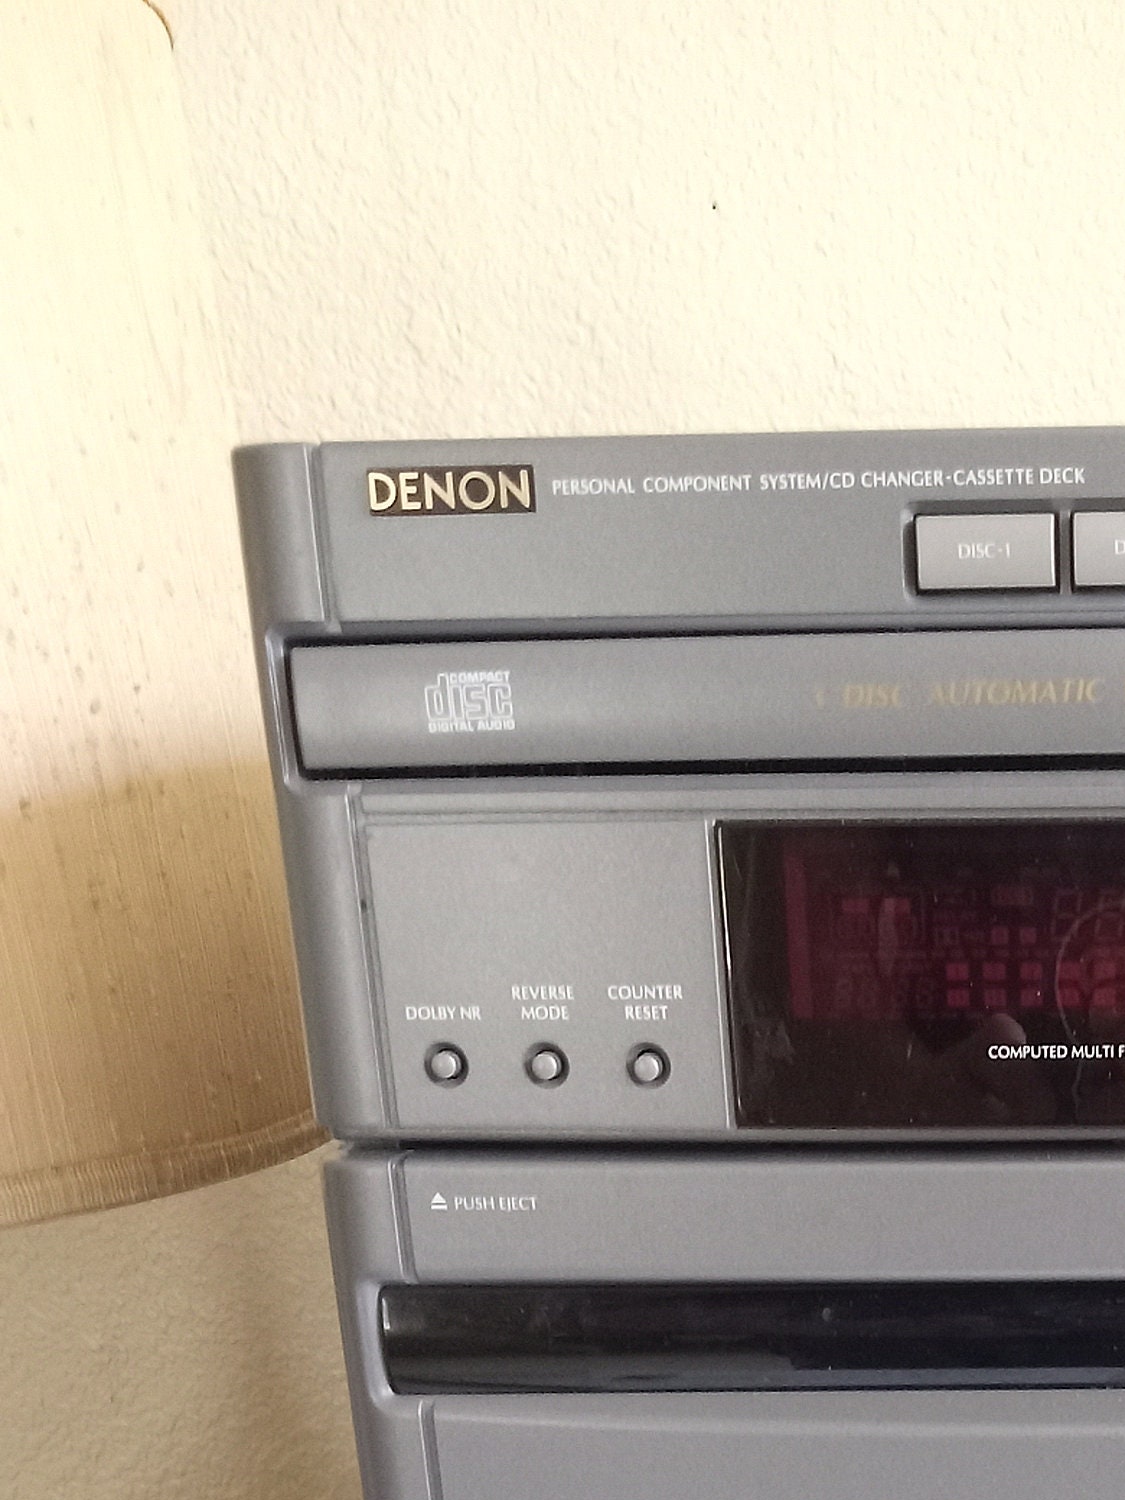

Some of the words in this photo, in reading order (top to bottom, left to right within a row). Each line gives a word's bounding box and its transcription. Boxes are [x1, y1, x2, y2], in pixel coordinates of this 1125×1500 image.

[552, 478, 635, 495] PERSONAL
[642, 474, 752, 493] COMPONENT
[759, 472, 855, 491] SYSTEM/CD
[1039, 467, 1086, 485] DECK
[367, 469, 531, 511] DENON
[449, 671, 510, 683] COMPACT
[932, 677, 1103, 706] AUTOMATIC
[428, 720, 474, 733] DIGITAL
[477, 719, 515, 731] AUDIO
[511, 985, 575, 1001] REVERSE
[607, 984, 684, 1001] COUNTER
[405, 1005, 456, 1021] DOLBY
[460, 1005, 482, 1021] NR
[520, 1004, 570, 1020] MODE
[624, 1005, 669, 1020] RESET
[987, 1043, 1069, 1061] COMPUTED
[1071, 1043, 1116, 1060] MULTI
[454, 1195, 496, 1211] PUSH
[499, 1195, 538, 1212] EJECT
